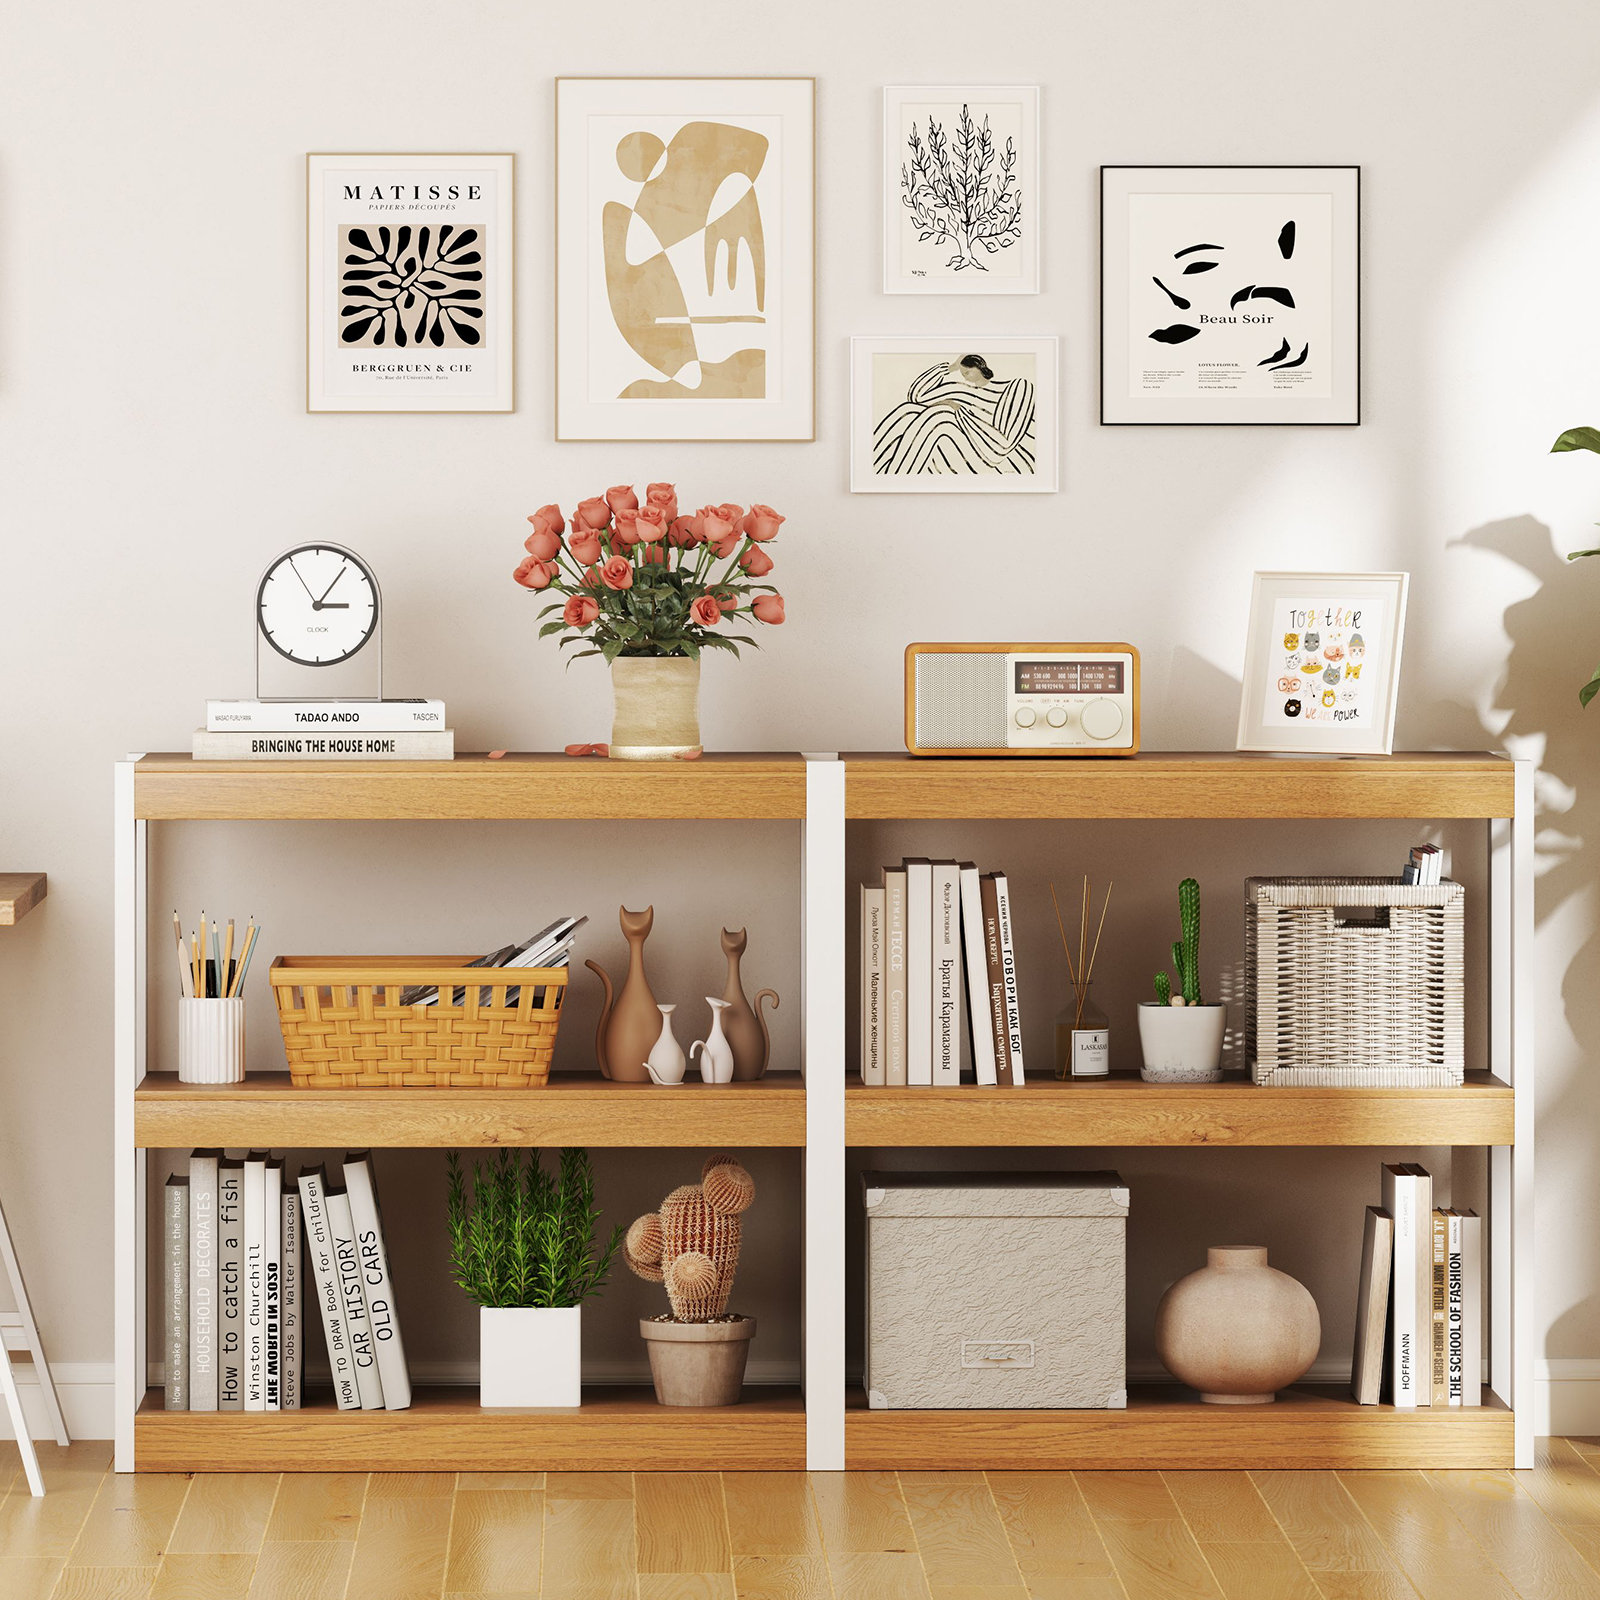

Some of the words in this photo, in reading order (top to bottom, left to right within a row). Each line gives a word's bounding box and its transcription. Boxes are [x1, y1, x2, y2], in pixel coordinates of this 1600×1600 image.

[343, 185, 482, 200] MATISSE
[408, 202, 456, 210] DÉCOUPÉS
[1199, 314, 1237, 324] Beau
[1242, 314, 1274, 324] Soir
[352, 364, 432, 372] BERGGRUEN
[436, 364, 444, 372] &
[449, 364, 472, 372] CIE
[294, 713, 329, 722] TADAO
[332, 713, 360, 722] ANDO
[252, 740, 302, 752] BRINGING
[306, 740, 325, 752] THE
[328, 740, 362, 752] HOUSE
[366, 740, 395, 752] HOME
[871, 906, 879, 927] Луиза
[891, 930, 902, 972] ГЕССЕ
[938, 959, 954, 998] Братья
[1003, 950, 1016, 1004] ГОВОРИ
[871, 972, 880, 1023] Маленькие
[992, 983, 1004, 1034] Бархатная
[1008, 1008, 1018, 1030] КАК
[870, 1024, 879, 1069] женщины
[938, 1001, 954, 1070] Карамазовы
[1011, 1034, 1021, 1054] БОГ
[221, 1179, 238, 1224] fish
[306, 1182, 325, 1243] children
[197, 1192, 210, 1277] DECORATES
[285, 1196, 295, 1254] Isaacson
[1434, 1220, 1444, 1233] J.K.
[172, 1245, 180, 1255] in
[226, 1238, 238, 1248] a
[359, 1231, 382, 1285] CARS
[1434, 1234, 1444, 1263] ROWLING
[319, 1251, 331, 1273] for
[1434, 1264, 1444, 1286] HARRY
[172, 1261, 182, 1321] arrangement
[221, 1261, 238, 1319] catch
[249, 1243, 260, 1326] Churchill
[285, 1262, 295, 1305] Walter
[336, 1237, 365, 1320] HISTORY
[1450, 1252, 1461, 1303] FASHION
[323, 1281, 337, 1311] Book
[1434, 1287, 1444, 1310] POTTER
[285, 1312, 296, 1326] by
[371, 1300, 393, 1341] OLD
[1450, 1307, 1461, 1322] OF
[174, 1326, 180, 1338] an
[197, 1287, 210, 1373] HOUSEHOLD
[223, 1332, 238, 1354] to
[330, 1318, 344, 1350] DRAW
[172, 1343, 180, 1365] make
[285, 1334, 295, 1362] Jobs
[352, 1332, 373, 1368] CAR
[1402, 1334, 1410, 1390] HOFFMANN
[1450, 1325, 1461, 1372] SCHOOL
[172, 1370, 180, 1381] to
[249, 1336, 260, 1401] Winston
[336, 1357, 348, 1373] TO
[1434, 1358, 1443, 1384] SECRETS
[221, 1366, 238, 1401] How
[285, 1370, 295, 1406] Steve
[341, 1380, 353, 1404] HOW
[1450, 1376, 1461, 1399] THE
